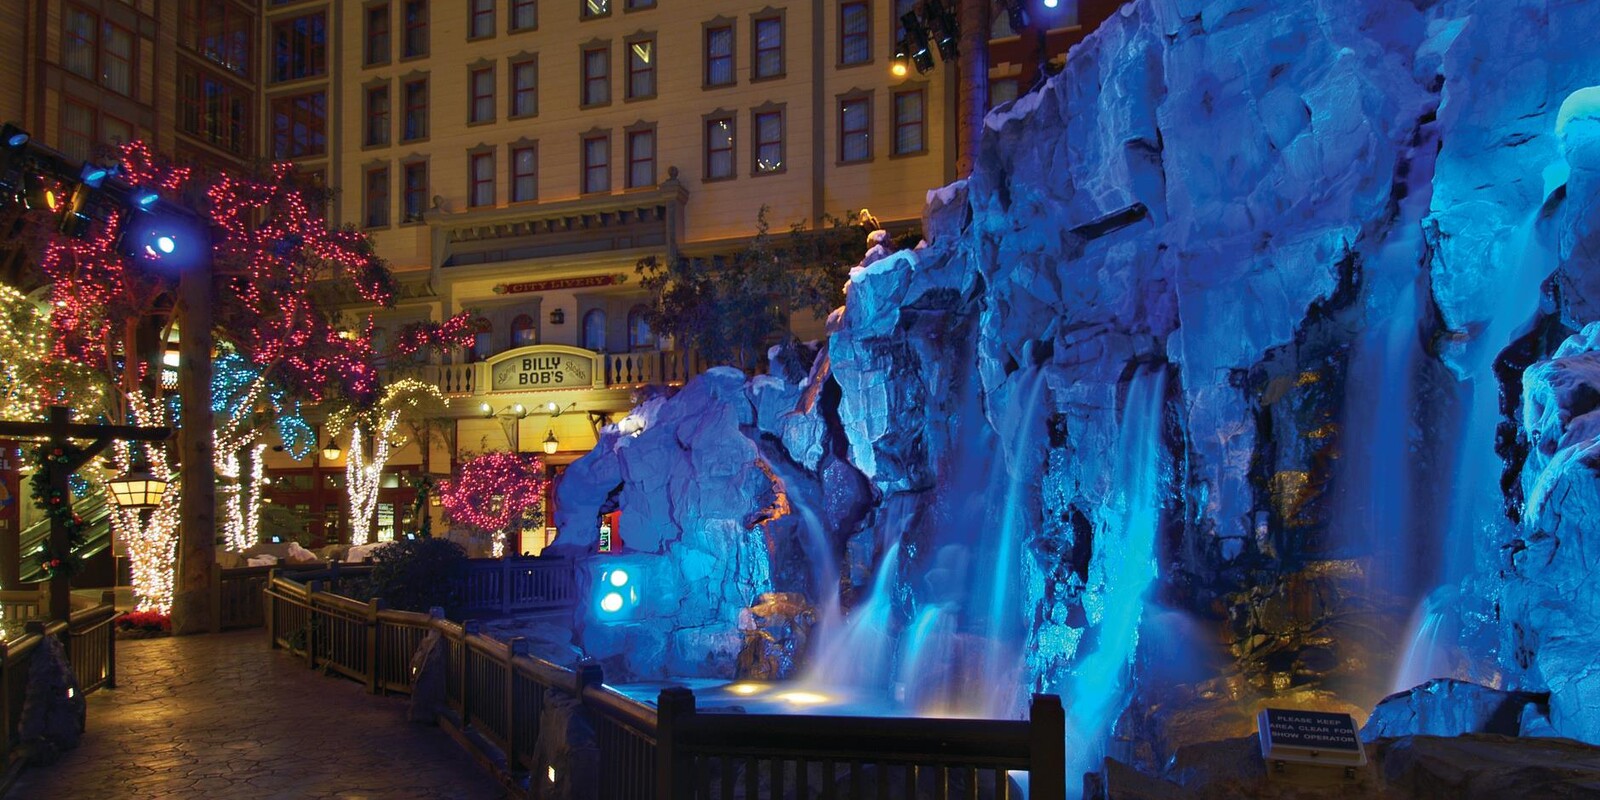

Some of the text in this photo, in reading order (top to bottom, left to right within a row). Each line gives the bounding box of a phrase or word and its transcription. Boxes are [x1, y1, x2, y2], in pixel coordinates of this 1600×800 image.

[513, 277, 604, 292] CITY LIVERY
[522, 357, 561, 371] BILLY
[519, 371, 564, 385] BOB'S
[1298, 725, 1329, 733] CLEAR
[1303, 734, 1355, 742] OPERATOR
